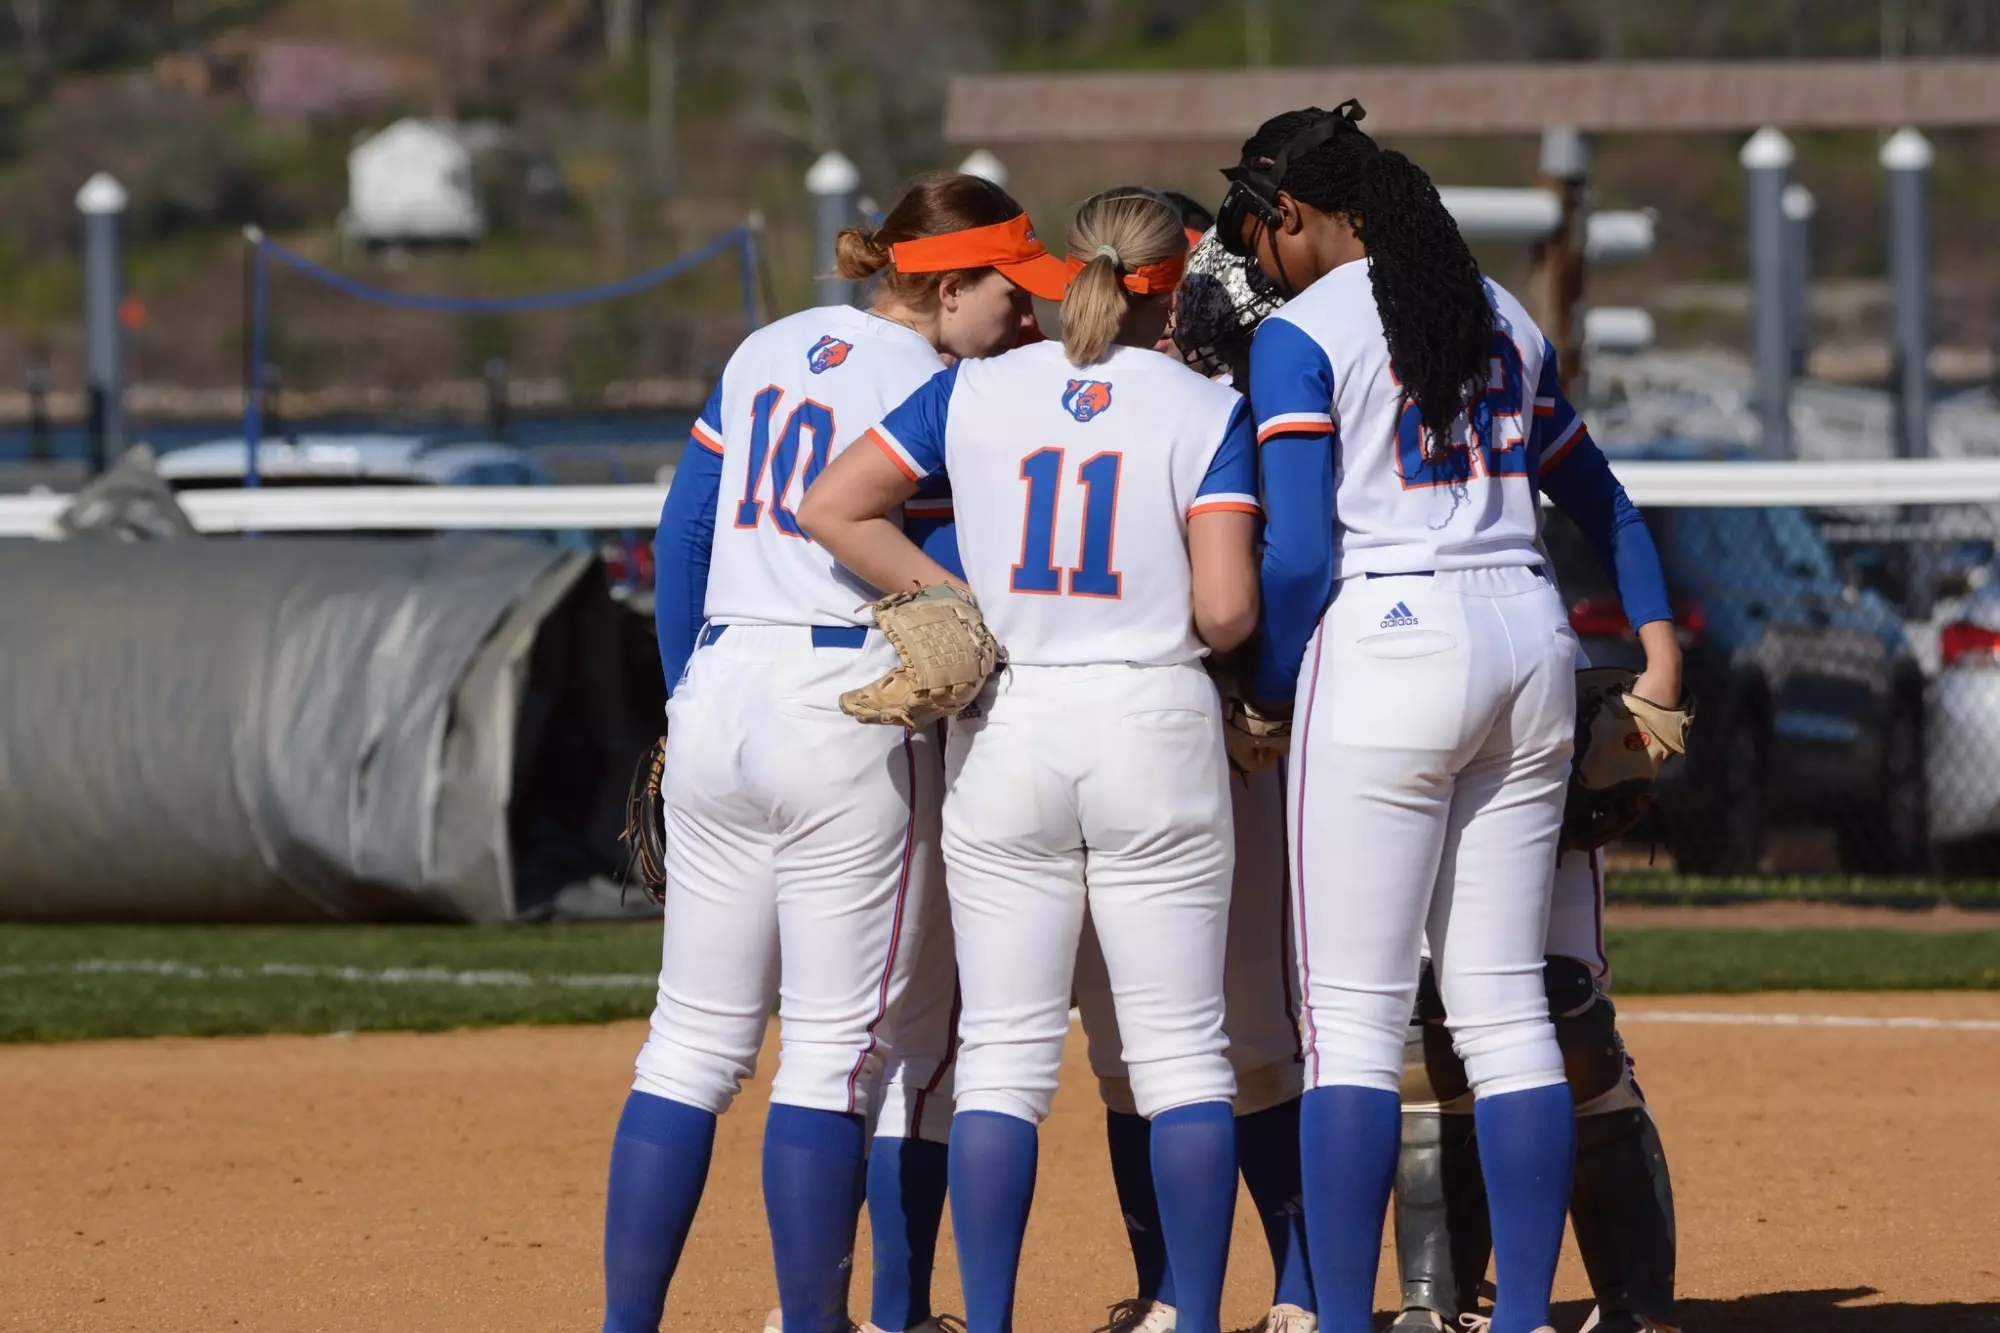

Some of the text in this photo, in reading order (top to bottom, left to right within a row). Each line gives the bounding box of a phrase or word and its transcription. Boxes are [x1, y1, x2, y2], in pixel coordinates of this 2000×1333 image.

[734, 384, 836, 543] 10
[1009, 446, 1122, 600] 11
[1380, 617, 1419, 628] adidas
